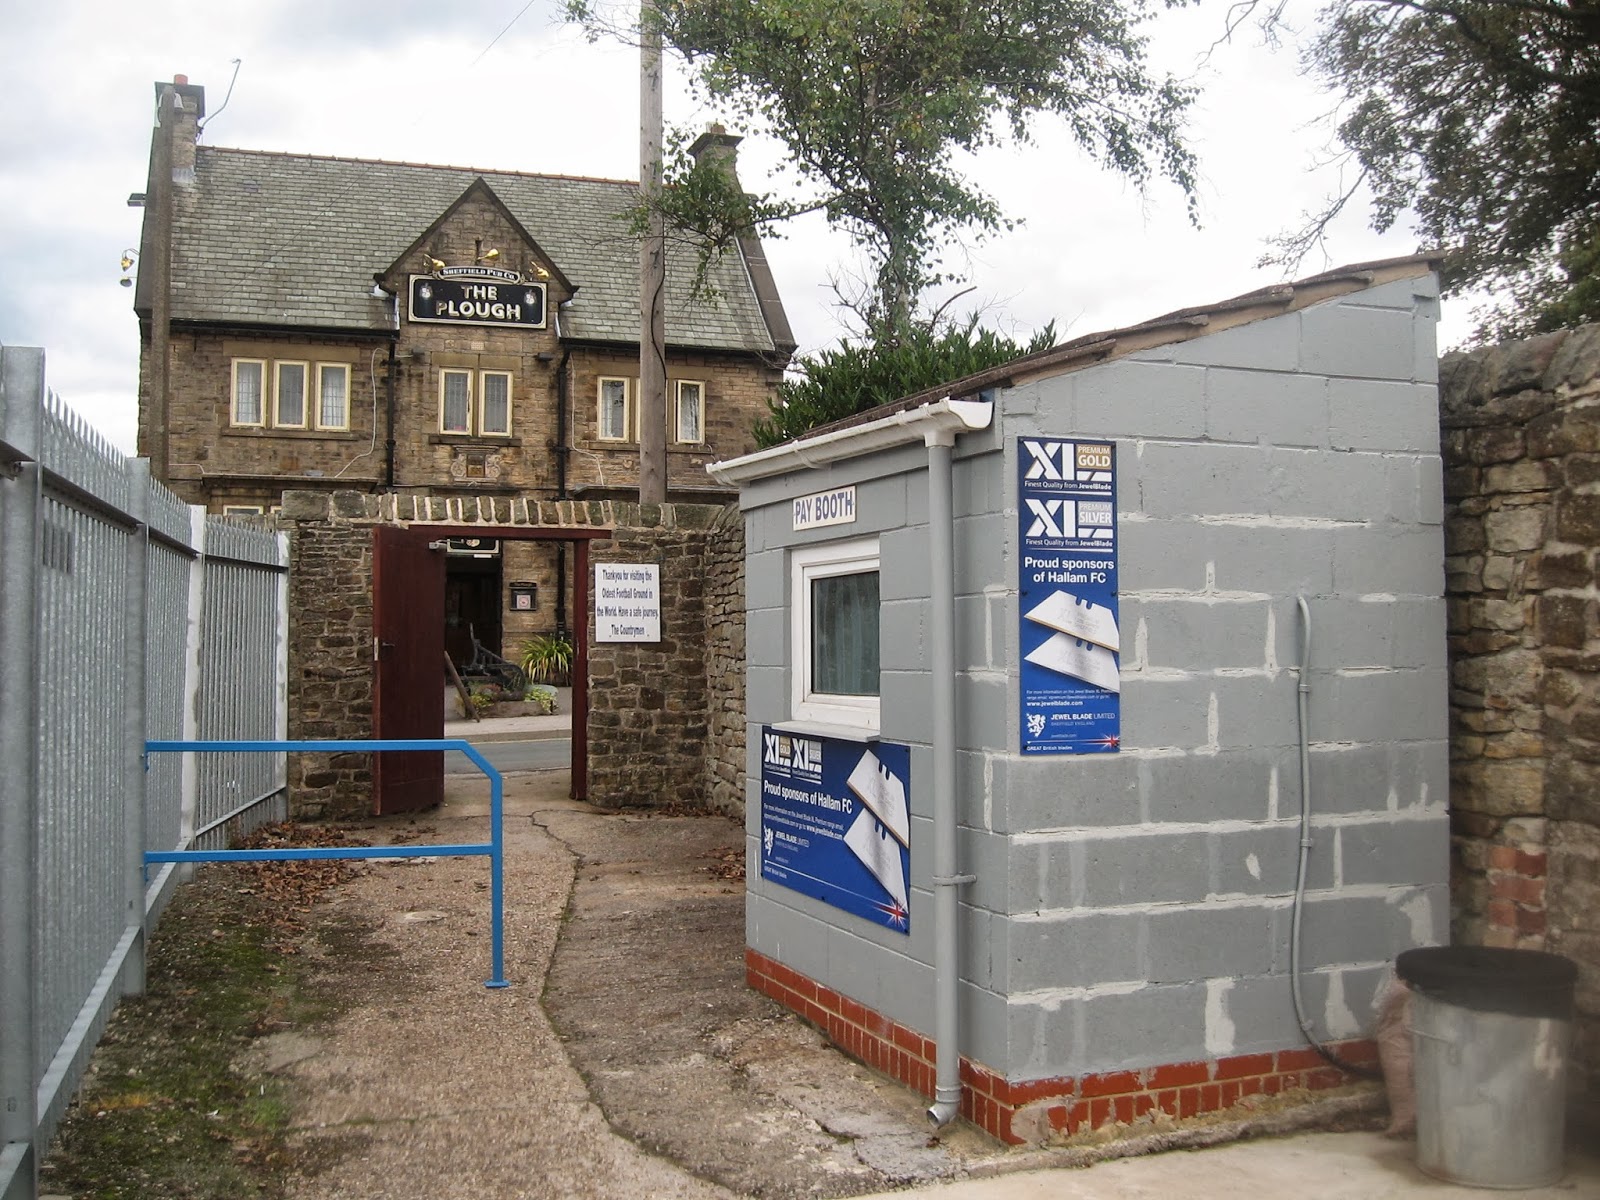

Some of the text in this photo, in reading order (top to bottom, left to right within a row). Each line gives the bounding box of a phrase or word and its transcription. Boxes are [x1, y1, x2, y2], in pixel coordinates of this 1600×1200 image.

[487, 269, 503, 277] PUB
[461, 285, 498, 300] THE
[435, 300, 521, 320] PLOUGH
[1078, 445, 1110, 455] PREMIUM
[1078, 454, 1111, 467] GOLD
[1043, 481, 1064, 489] Quality
[795, 490, 853, 525] PAY BOOTH
[1079, 503, 1111, 512] PREMIUM
[1079, 511, 1112, 524] SILVER
[1044, 539, 1064, 547] Quality
[1024, 557, 1115, 571] Proud sponsors
[602, 569, 622, 583] Thankyou
[630, 570, 645, 583] visiting
[1033, 571, 1107, 583] of Hallam FC
[601, 588, 653, 599] Oldest Football Ground in
[618, 606, 629, 617] Have
[633, 607, 642, 617] safe
[611, 624, 645, 638] The Countrymen
[764, 779, 852, 814] Proud sponsors of Hallam FC
